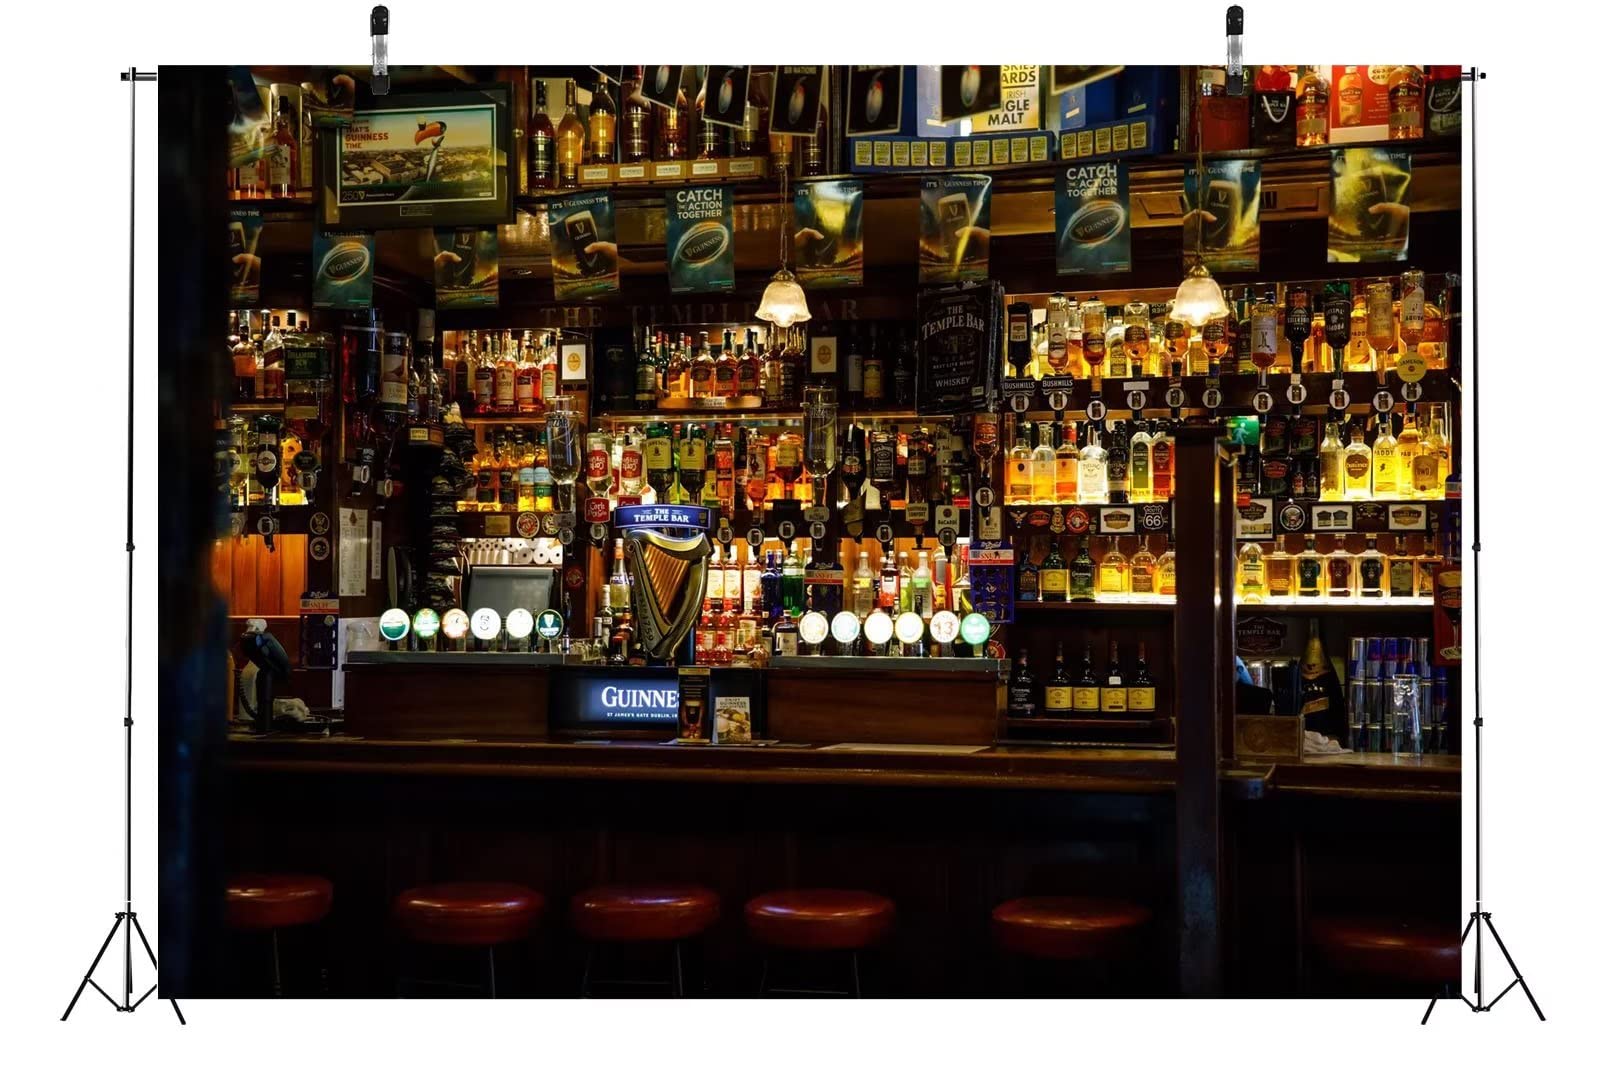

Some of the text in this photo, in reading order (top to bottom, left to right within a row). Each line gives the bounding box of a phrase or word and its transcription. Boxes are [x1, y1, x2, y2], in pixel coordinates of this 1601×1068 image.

[1002, 71, 1036, 84] ARDS
[988, 112, 1025, 126] MALT
[345, 132, 389, 142] GUINNESS
[345, 142, 362, 150] TIME
[1066, 164, 1118, 181] CATCH
[1079, 177, 1118, 189] ACTION
[676, 188, 723, 202] CATCH
[1067, 186, 1118, 198] TOGETHER
[688, 200, 723, 211] ACTION
[677, 209, 722, 219] TOGETHER
[946, 304, 964, 315] THE
[540, 306, 603, 328] THE
[921, 312, 985, 341] TEMPLE BAR
[935, 375, 972, 388] WHISKEY
[1004, 381, 1036, 390] BUSHMILLS
[1042, 379, 1074, 388] BUSHMILLS
[633, 514, 690, 524] TEMPLE BAR
[1145, 515, 1161, 526] 66
[601, 686, 679, 708] GUINNE
